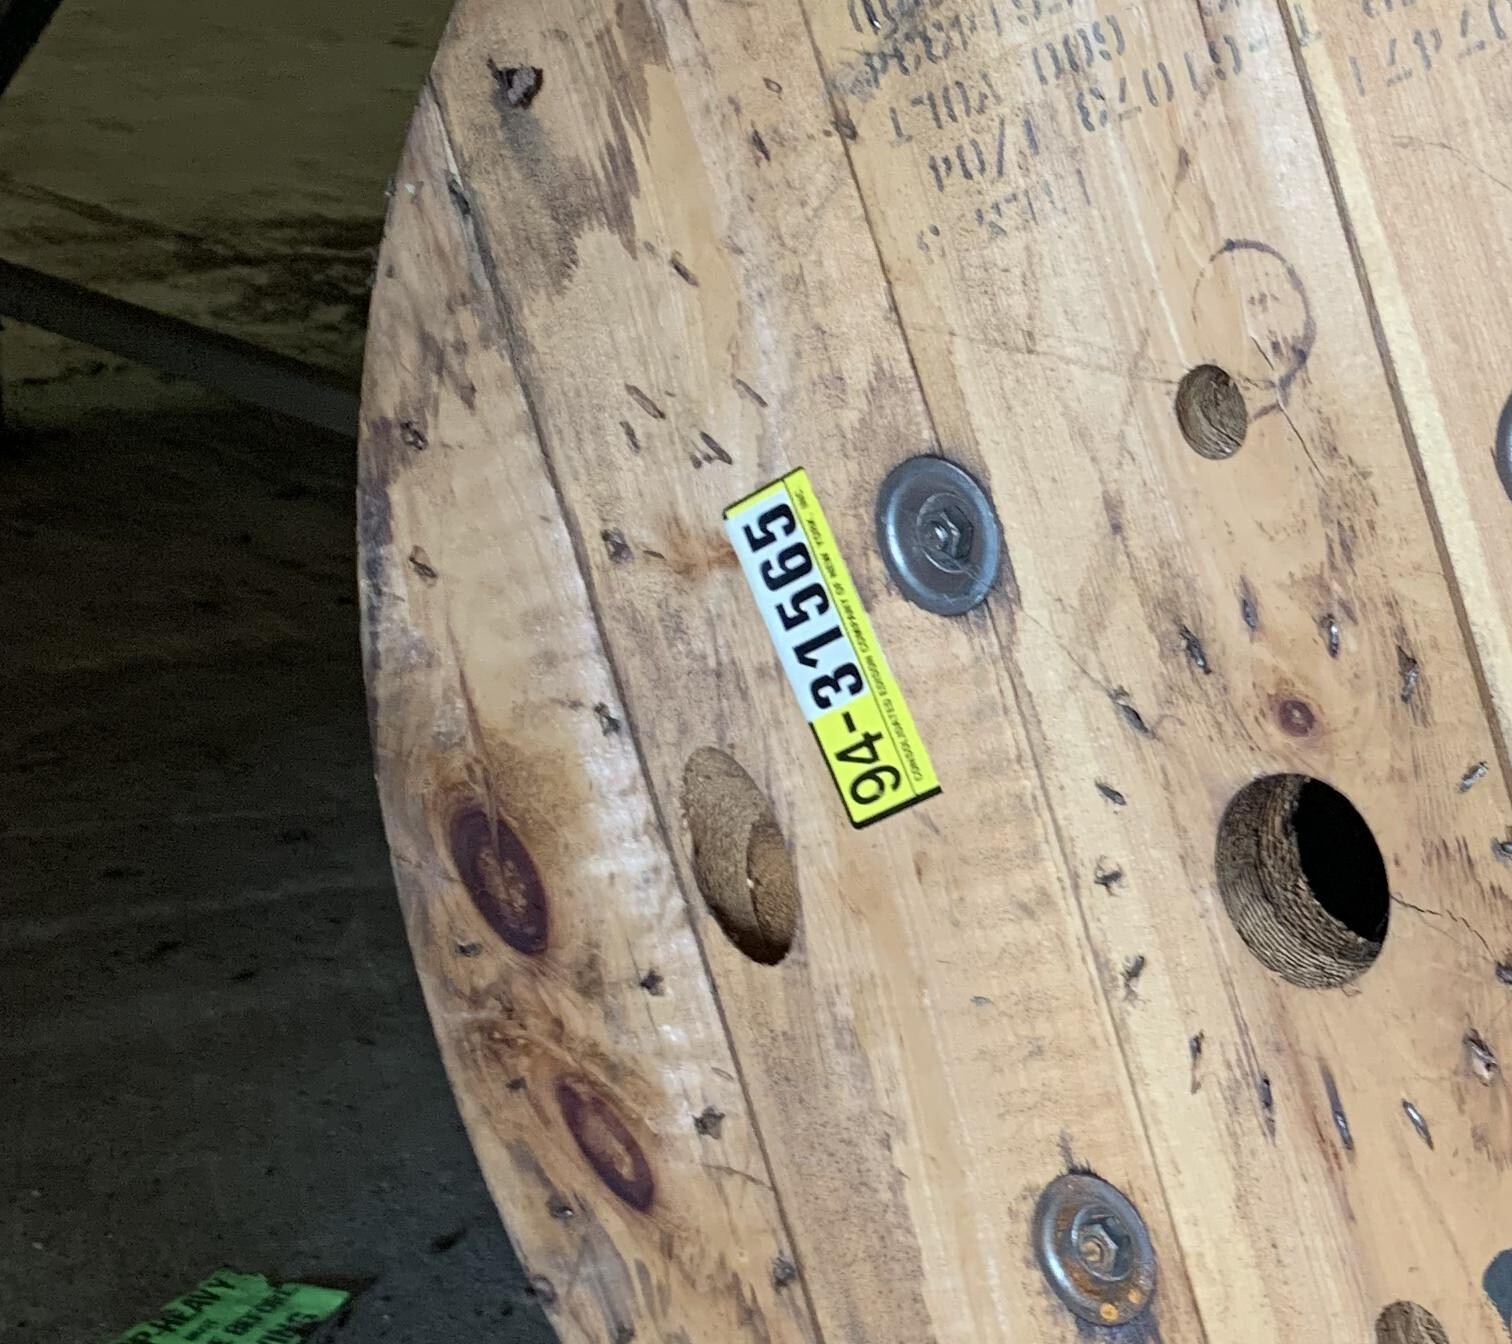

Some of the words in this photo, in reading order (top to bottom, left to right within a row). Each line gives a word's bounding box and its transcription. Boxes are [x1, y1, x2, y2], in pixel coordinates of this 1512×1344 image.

[889, 72, 1002, 147] VOLT
[820, 550, 839, 579] NEW
[743, 503, 900, 805] 94-31565
[841, 597, 870, 654] COMPANY
[864, 654, 888, 697] EDISON
[881, 697, 923, 782] CONSOLIDATED
